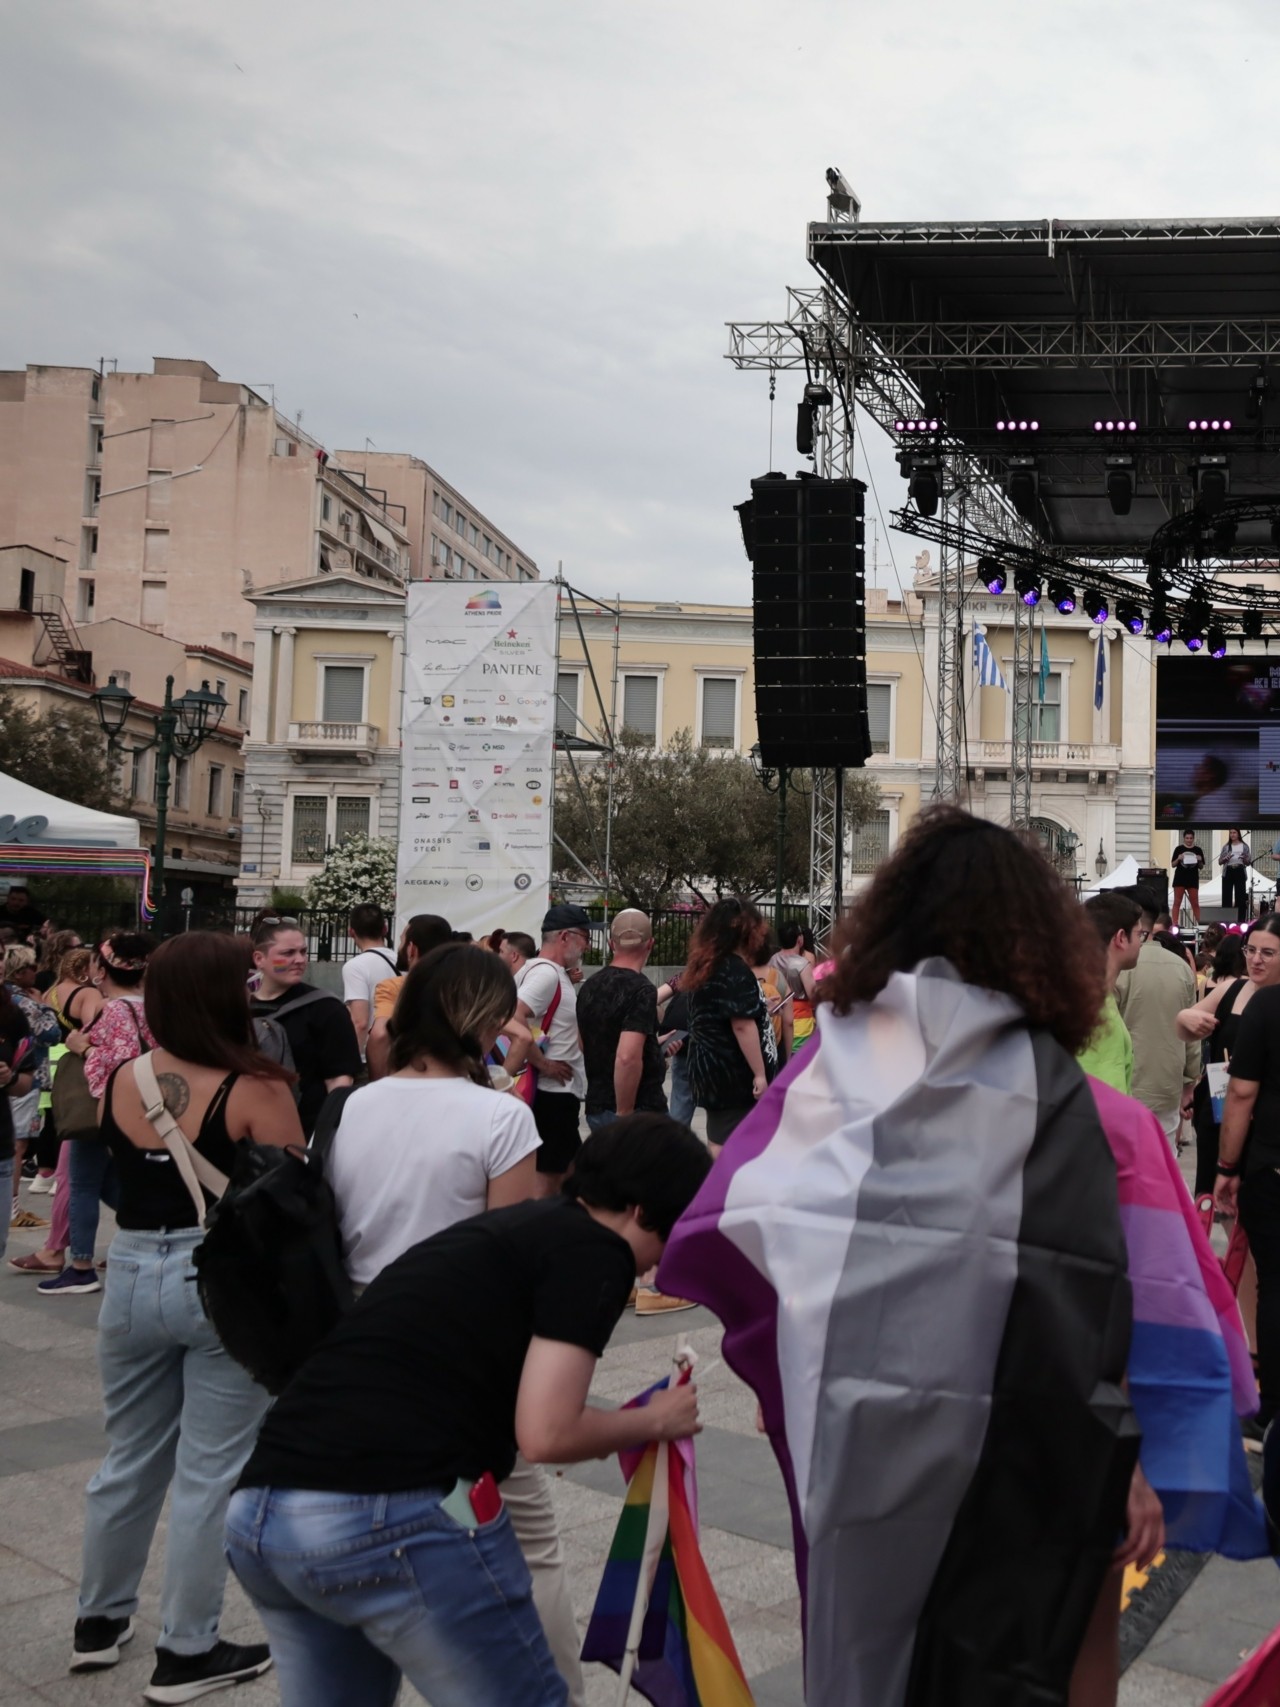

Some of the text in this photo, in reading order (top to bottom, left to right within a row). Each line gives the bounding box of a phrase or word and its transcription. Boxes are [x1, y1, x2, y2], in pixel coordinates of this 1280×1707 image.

[494, 640, 530, 648] Heineken
[483, 664, 542, 676] PANTENE
[1255, 678, 1268, 688] ΚΙ
[517, 697, 547, 707] Google
